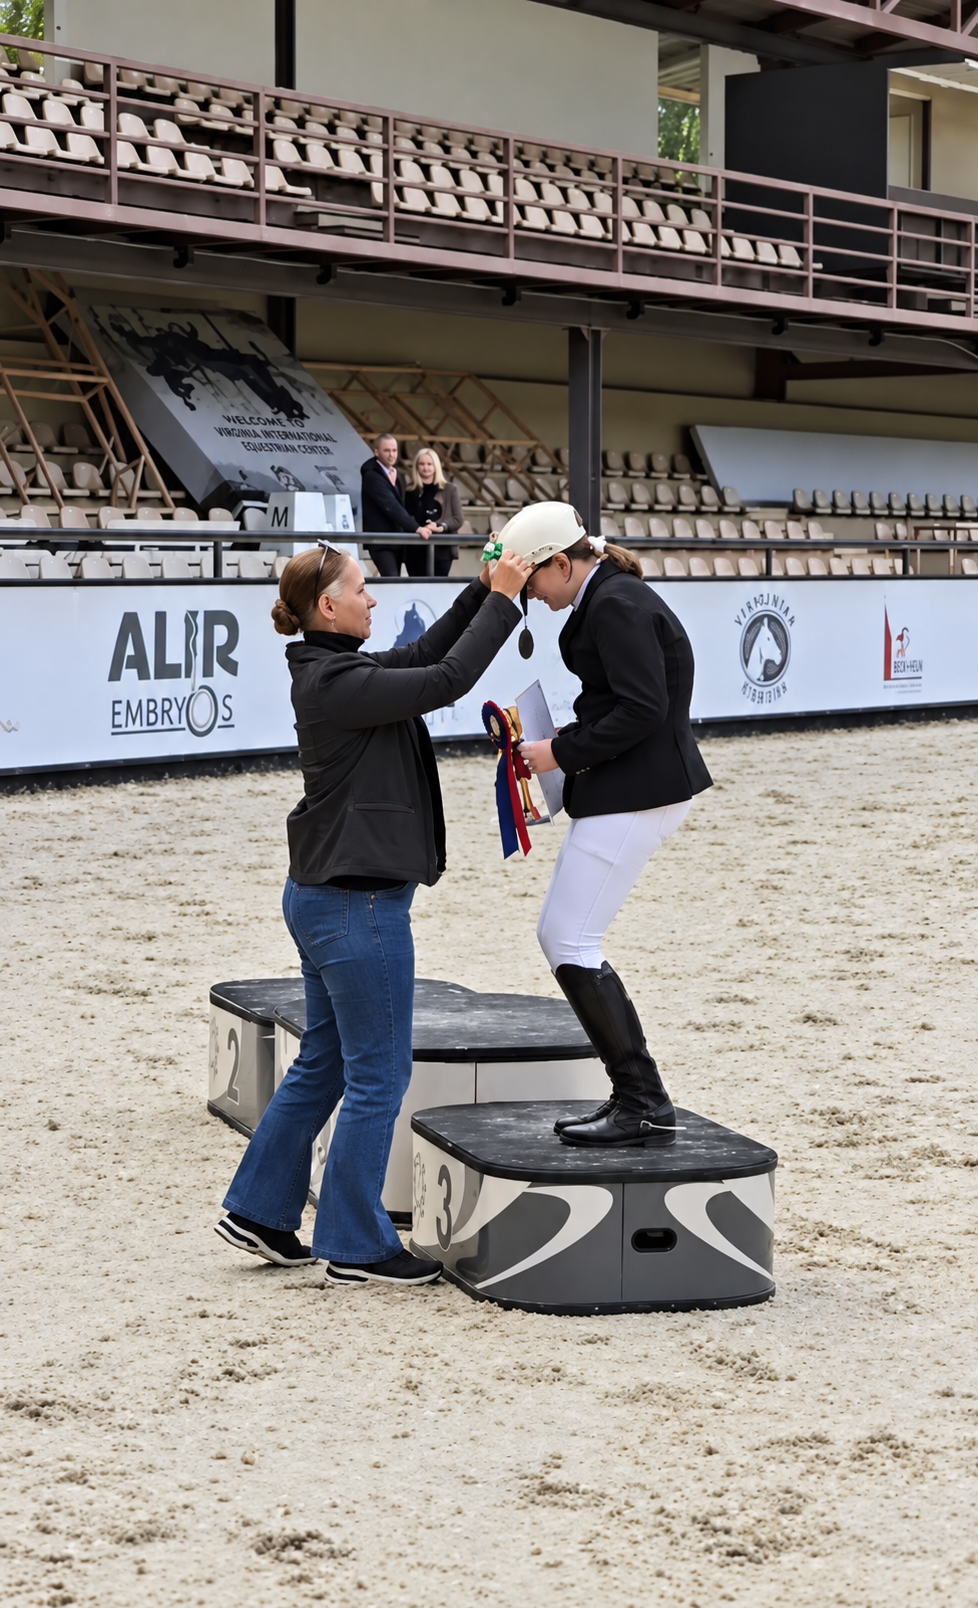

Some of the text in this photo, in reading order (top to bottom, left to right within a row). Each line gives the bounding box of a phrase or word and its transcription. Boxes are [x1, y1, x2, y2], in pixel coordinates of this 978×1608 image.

[222, 414, 305, 428] WELCOME TO
[214, 427, 337, 443] VIRGINIA INTERNATIONAL
[241, 441, 334, 455] EQUESTRIAN CENTER
[271, 507, 288, 527] M
[111, 685, 233, 737] EMBRYOS
[226, 1027, 240, 1106] 2
[435, 1164, 452, 1251] 3
